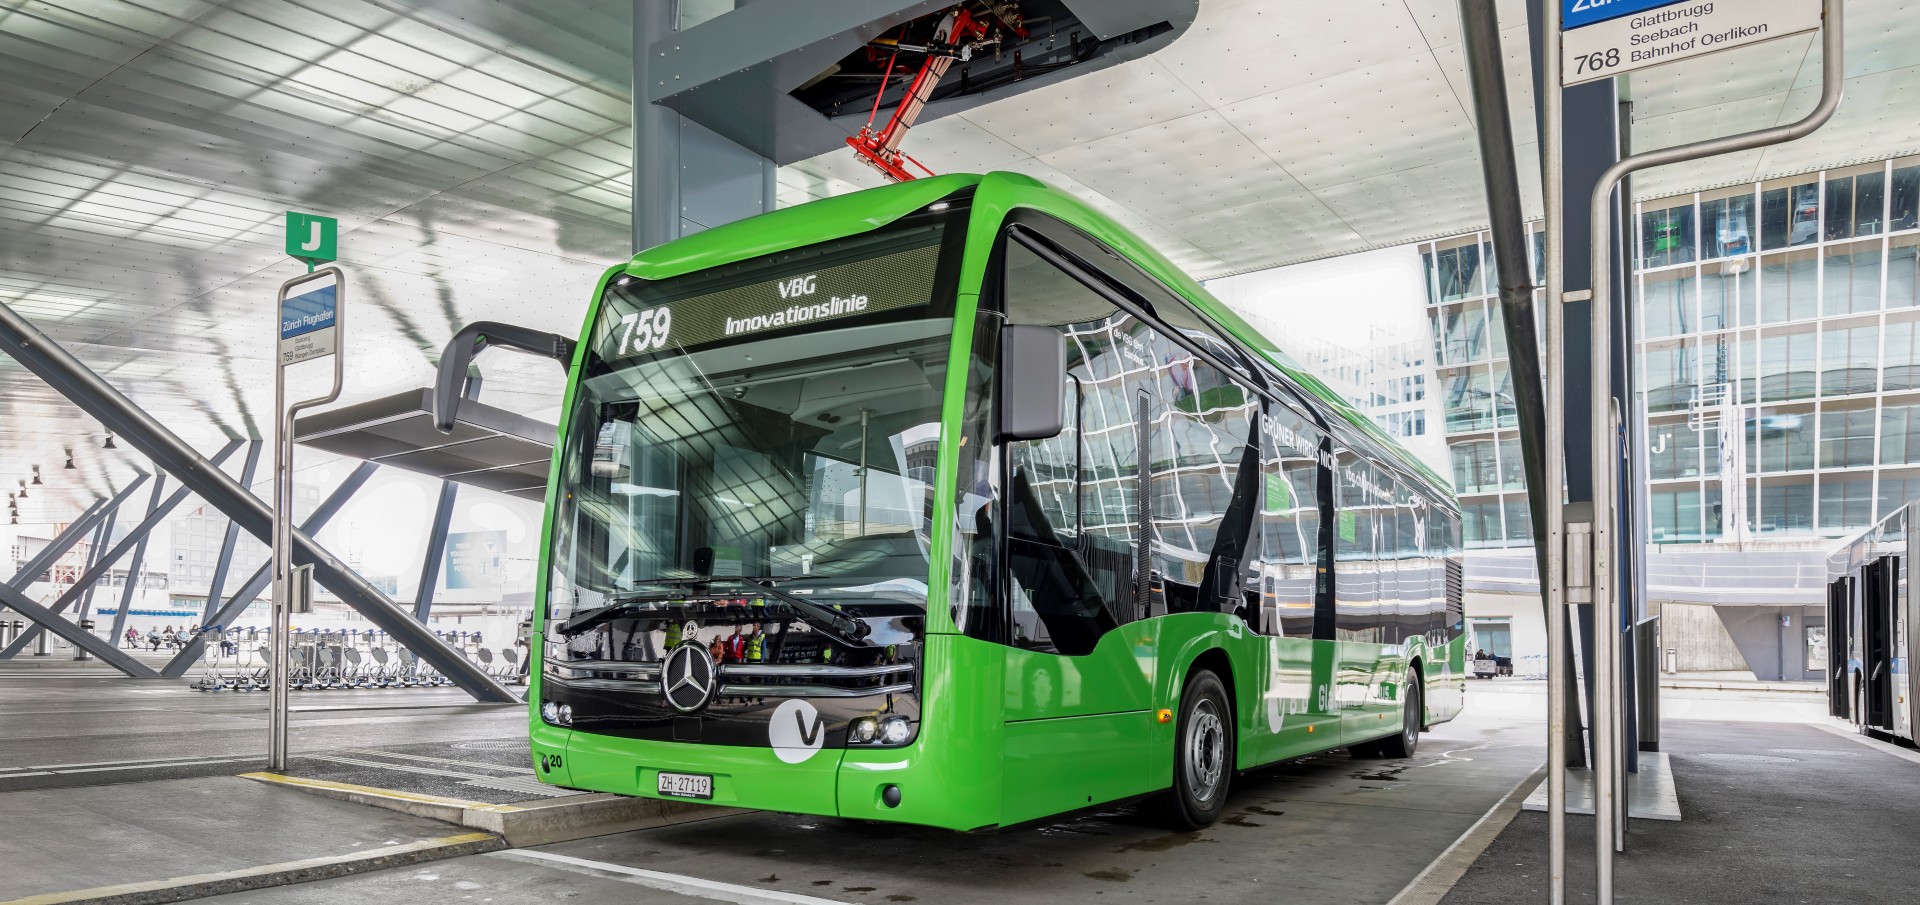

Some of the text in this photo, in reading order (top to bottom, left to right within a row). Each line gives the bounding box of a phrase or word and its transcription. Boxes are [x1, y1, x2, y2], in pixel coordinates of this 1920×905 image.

[1630, 2, 1714, 30] Glattbrugg
[1630, 21, 1698, 46] Seebach
[1630, 22, 1768, 63] Bahnhof Oerlikon
[1574, 48, 1621, 75] 768
[301, 221, 322, 251] J
[778, 274, 817, 299] VBG
[283, 310, 334, 332] Zürich Flughafen
[725, 294, 868, 335] Innovationslinie
[618, 306, 671, 355] 759
[283, 350, 294, 362] 759
[1262, 413, 1295, 449] GRÜNER
[550, 754, 562, 768] 20
